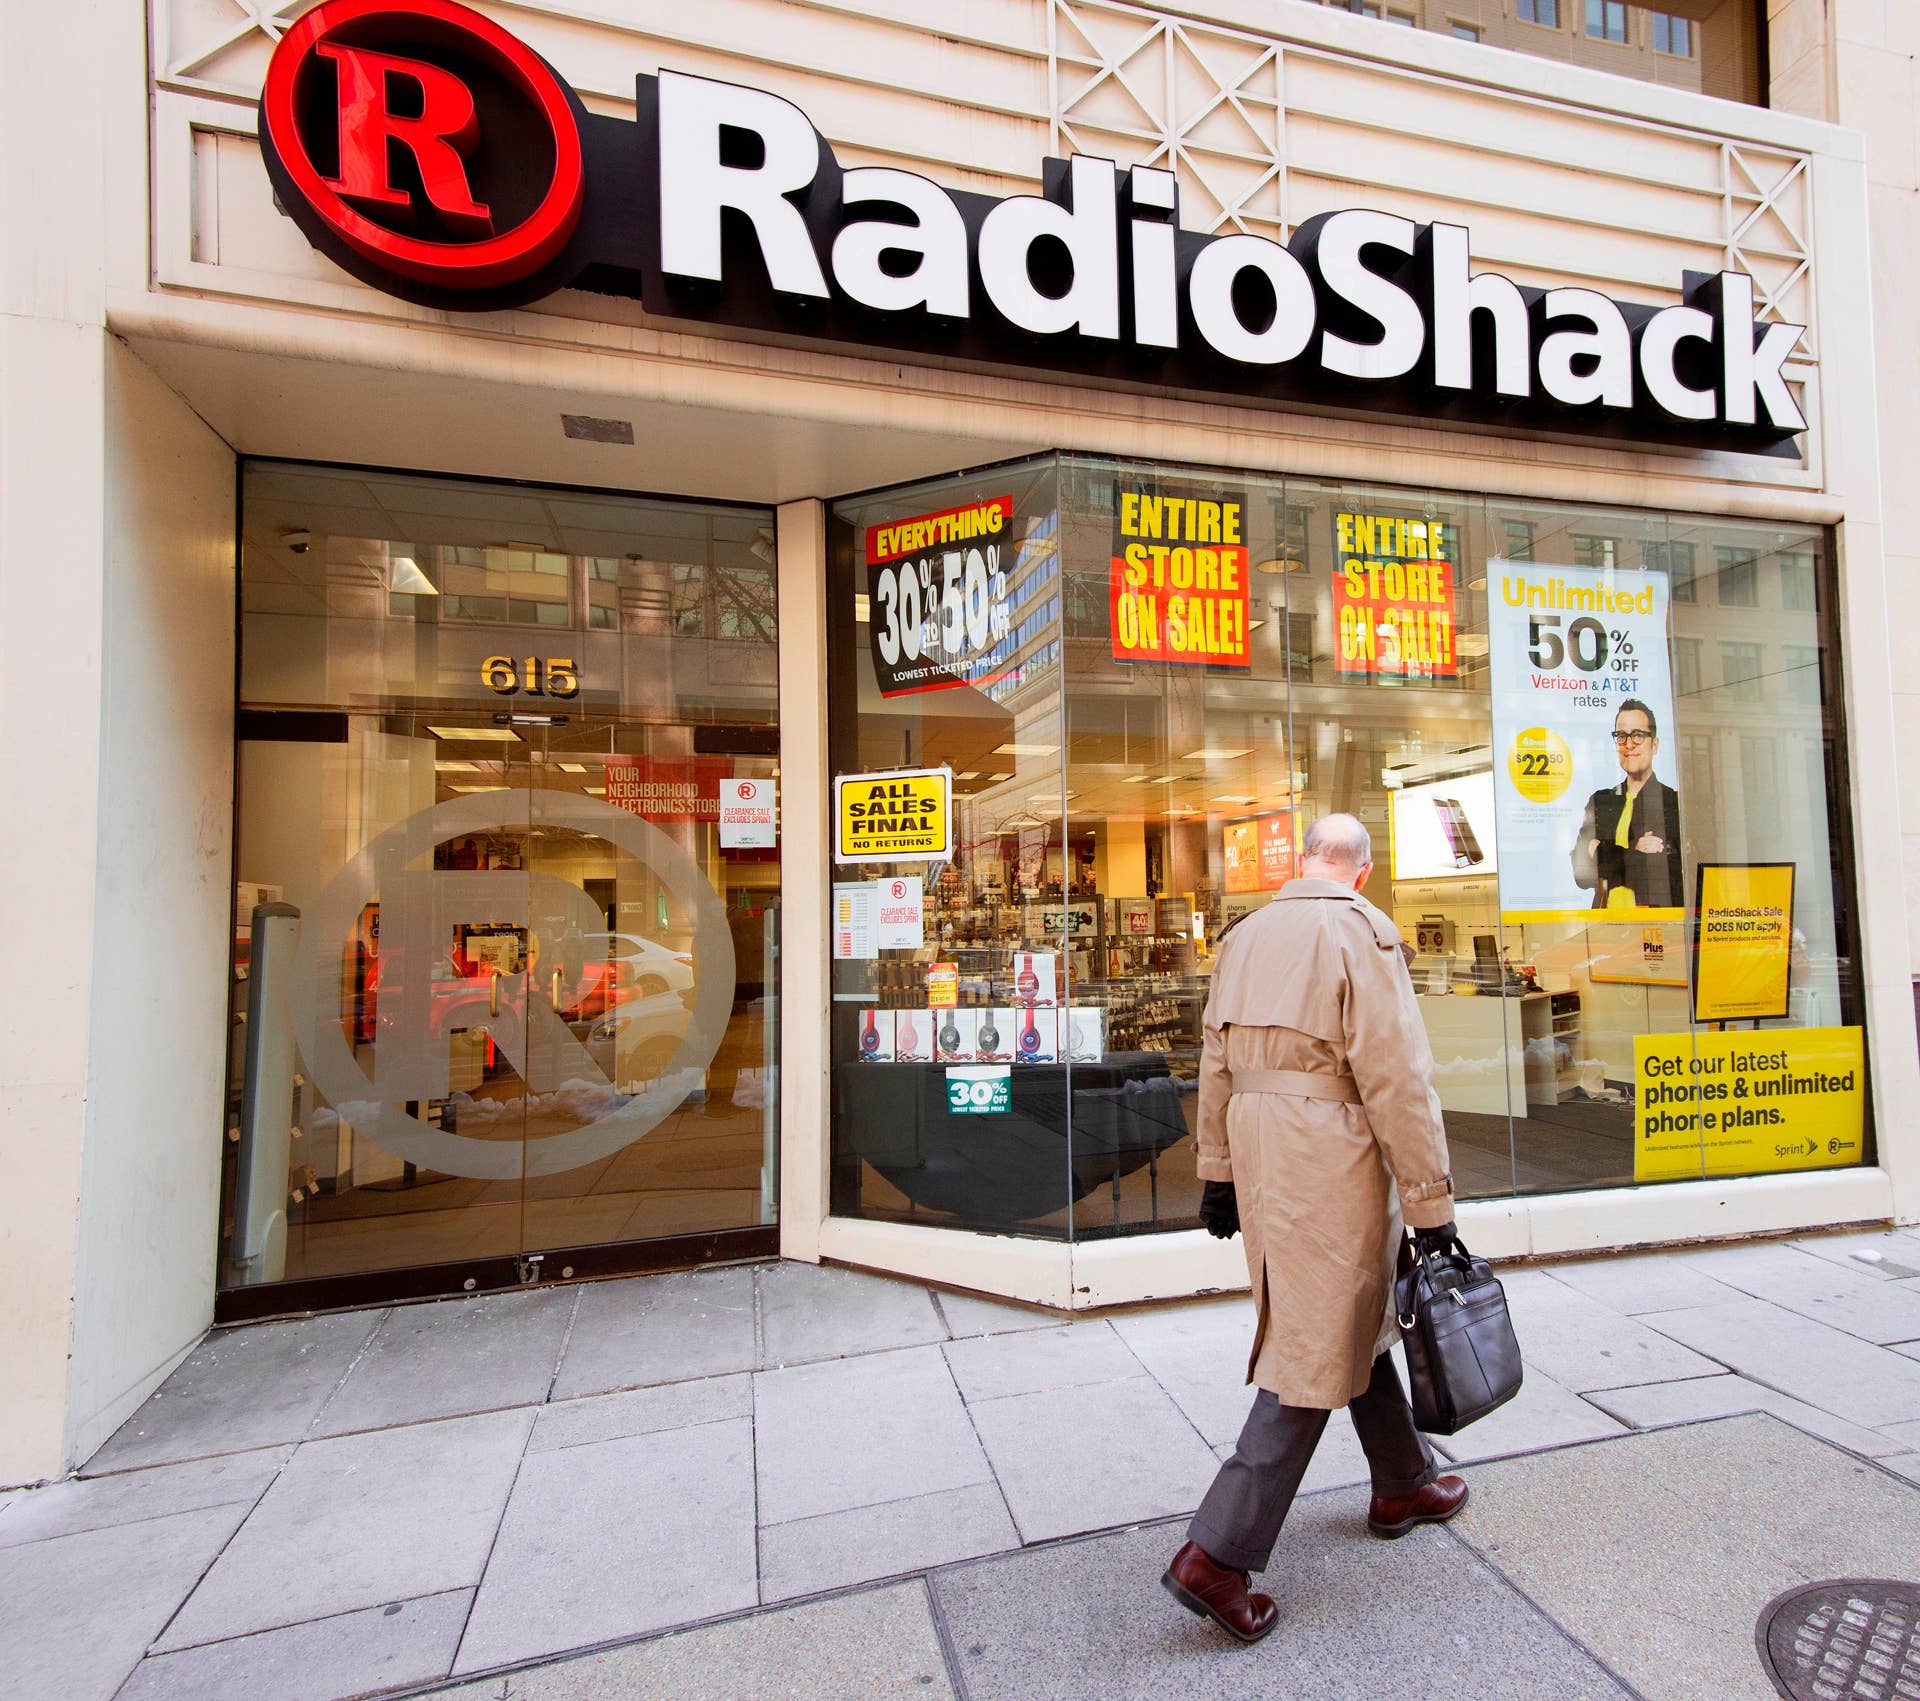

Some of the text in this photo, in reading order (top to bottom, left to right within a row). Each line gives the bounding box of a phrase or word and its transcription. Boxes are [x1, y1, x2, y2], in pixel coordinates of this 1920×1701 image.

[659, 69, 1807, 431] RadioShack
[1121, 493, 1241, 544] ENTIRE
[877, 503, 1003, 558] EVERYTHING
[1337, 513, 1445, 560] ENTIRE
[1125, 543, 1239, 591] STORE
[1344, 559, 1446, 603] STORE
[1502, 576, 1654, 615] Unlimited
[877, 559, 938, 666] 30%
[990, 602, 1011, 642] OFF
[1117, 592, 1243, 655] ON SALE!
[1340, 604, 1451, 665] ON SALE!
[481, 656, 578, 698] 615
[893, 655, 1003, 682] LOWEST TICKETED PRICE
[1611, 659, 1639, 673] OFF
[1530, 673, 1639, 692] Verizon & AT&T
[1573, 693, 1608, 708] rates
[609, 767, 640, 782] YOUR
[608, 783, 699, 798] NEIGHBORHOOD
[868, 783, 917, 800] ALL
[725, 807, 771, 816] CLEARANCE SALE
[849, 798, 937, 817] SALES
[724, 815, 771, 824] EXCLUDES SPRINT
[852, 817, 934, 834] FINAL
[853, 837, 933, 849] NO RETURNS
[1708, 906, 1783, 918] RadioShack Sale
[1642, 928, 1664, 943] LTE
[1707, 921, 1783, 932] DOES NOT apply
[1643, 943, 1664, 953] Plus
[1644, 1050, 1788, 1078] Get our latest
[950, 1081, 1008, 1106] 30% OFF
[1645, 1071, 1855, 1109] phones & unlimited
[1644, 1105, 1786, 1138] phone plans.
[1775, 1143, 1804, 1159] Sprint
